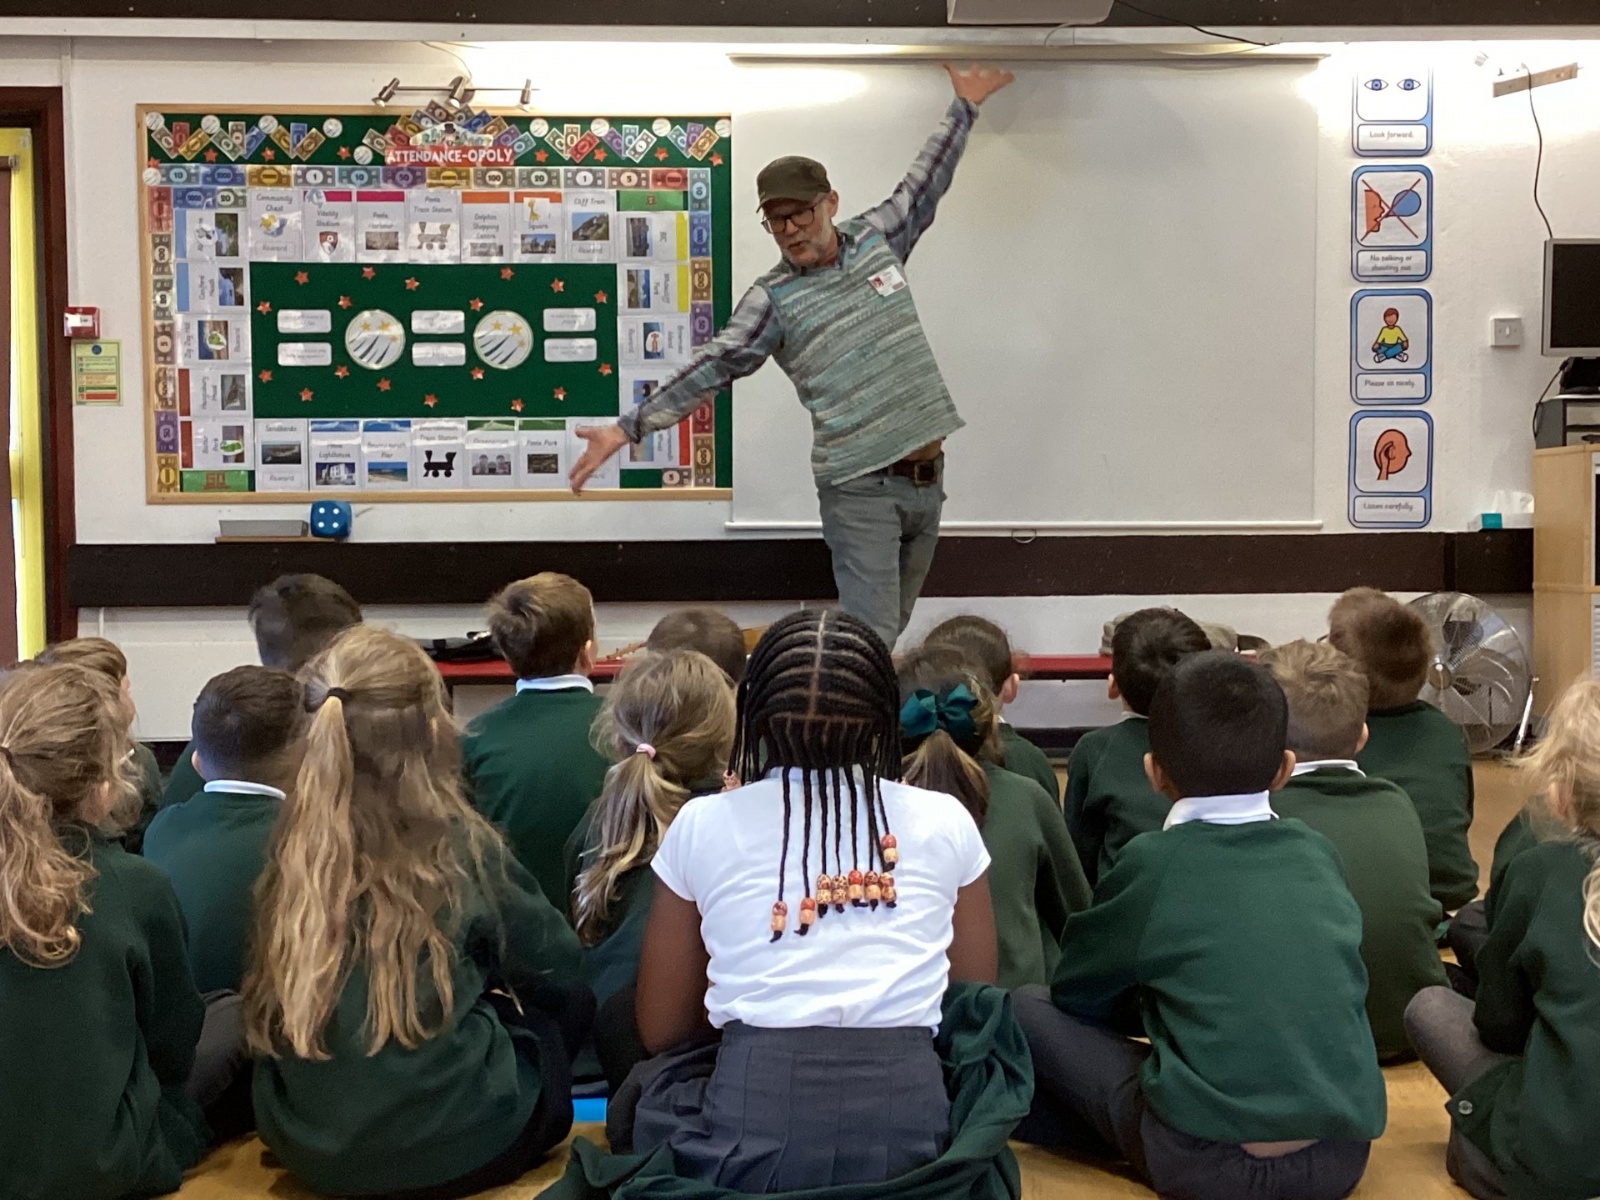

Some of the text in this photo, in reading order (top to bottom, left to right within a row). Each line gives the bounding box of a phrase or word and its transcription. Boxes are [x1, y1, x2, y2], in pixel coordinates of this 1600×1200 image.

[1369, 130, 1385, 138] Look
[387, 148, 513, 163] ATTENDANCE-OPOLY
[696, 187, 702, 196] 10
[256, 194, 293, 204] Community
[574, 197, 588, 207] Cliff
[317, 210, 338, 218] Vitality
[474, 213, 497, 222] Dolphin
[473, 223, 500, 232] Shopping
[528, 223, 549, 231] Square
[262, 244, 287, 252] Reward
[1381, 254, 1404, 264] talking
[1371, 264, 1399, 273] shouting
[1365, 379, 1385, 387] Please
[319, 451, 351, 460] Lighthouse
